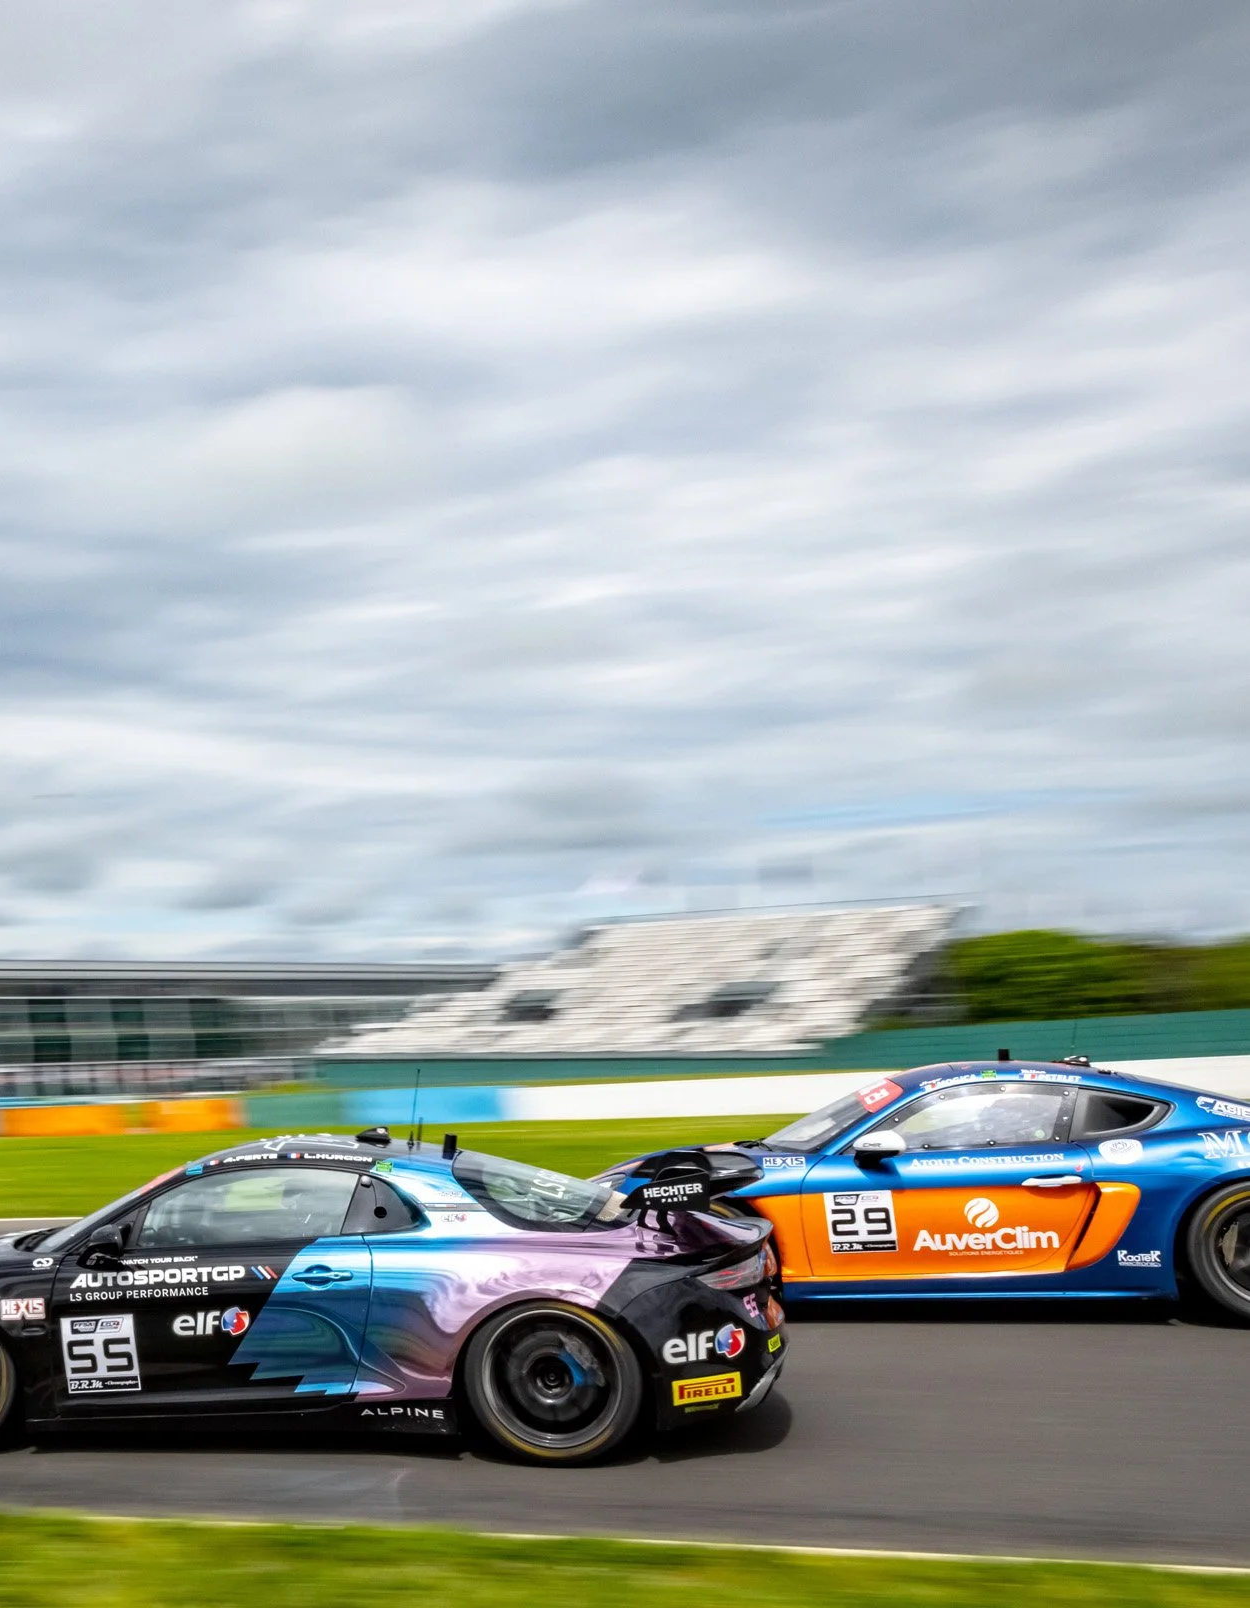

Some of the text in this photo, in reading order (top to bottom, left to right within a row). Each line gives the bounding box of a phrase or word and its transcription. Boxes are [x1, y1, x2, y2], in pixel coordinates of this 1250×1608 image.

[764, 1157, 805, 1169] HEXIS
[643, 1183, 703, 1198] HECHTER
[831, 1207, 892, 1236] 29
[913, 1226, 1060, 1251] AuverClim
[70, 1265, 246, 1289] AUTOSPORTGP
[70, 1286, 209, 1302] LS GROUP PERFORMANCE
[1, 1298, 45, 1320] HEXIS
[173, 1310, 222, 1336] elf
[67, 1337, 135, 1375] 55
[662, 1330, 714, 1364] elf
[678, 1378, 735, 1400] PIRELLI
[361, 1407, 445, 1420] ALPINE
